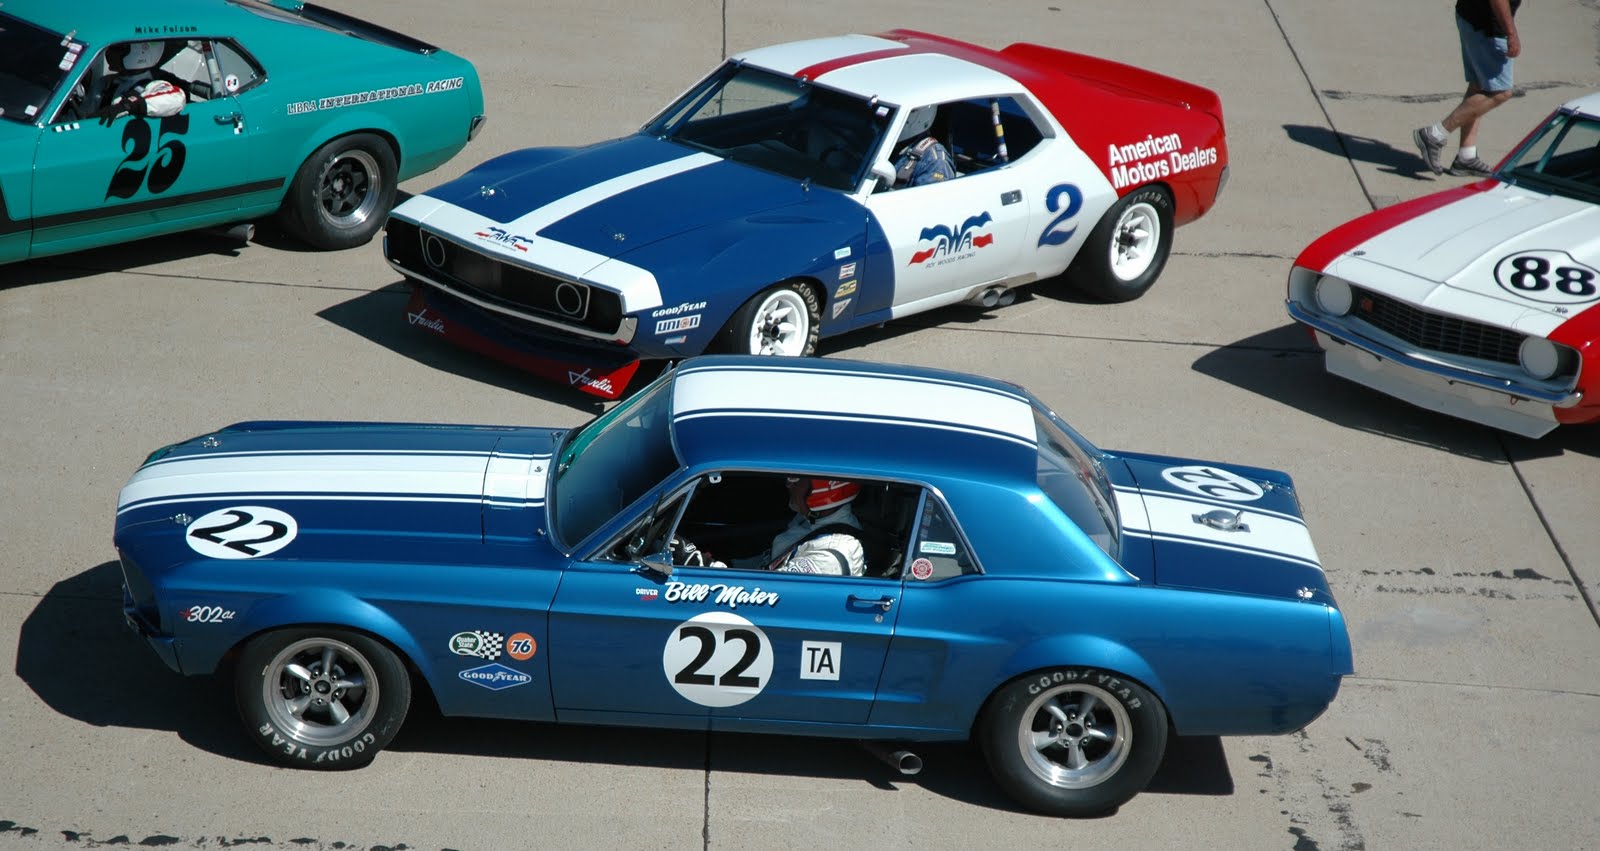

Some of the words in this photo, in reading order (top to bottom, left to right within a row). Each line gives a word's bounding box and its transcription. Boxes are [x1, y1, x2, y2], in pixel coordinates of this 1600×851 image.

[135, 26, 159, 34] Mike
[163, 25, 198, 33] Folsom
[287, 102, 318, 115] LIBRA
[319, 84, 424, 110] INTERNATIONAL
[426, 77, 464, 95] RACING
[104, 113, 190, 203] 25
[1108, 132, 1182, 167] American
[1110, 159, 1170, 190] Motors
[1170, 147, 1217, 175] Dealers
[1037, 183, 1084, 249] 2
[1510, 256, 1597, 297] 88
[652, 301, 707, 317] GOODYEAR
[568, 367, 614, 395] Javelin
[1169, 468, 1260, 497] 22
[188, 509, 289, 557] 22
[635, 587, 658, 596] DRIVER
[664, 581, 710, 602] Bill
[710, 583, 779, 609] Maier
[187, 605, 224, 623] 302
[456, 635, 477, 644] Quaker
[510, 638, 533, 655] 76
[674, 626, 762, 688] 22
[806, 647, 835, 674] TA
[463, 671, 528, 682] GOODYEAR
